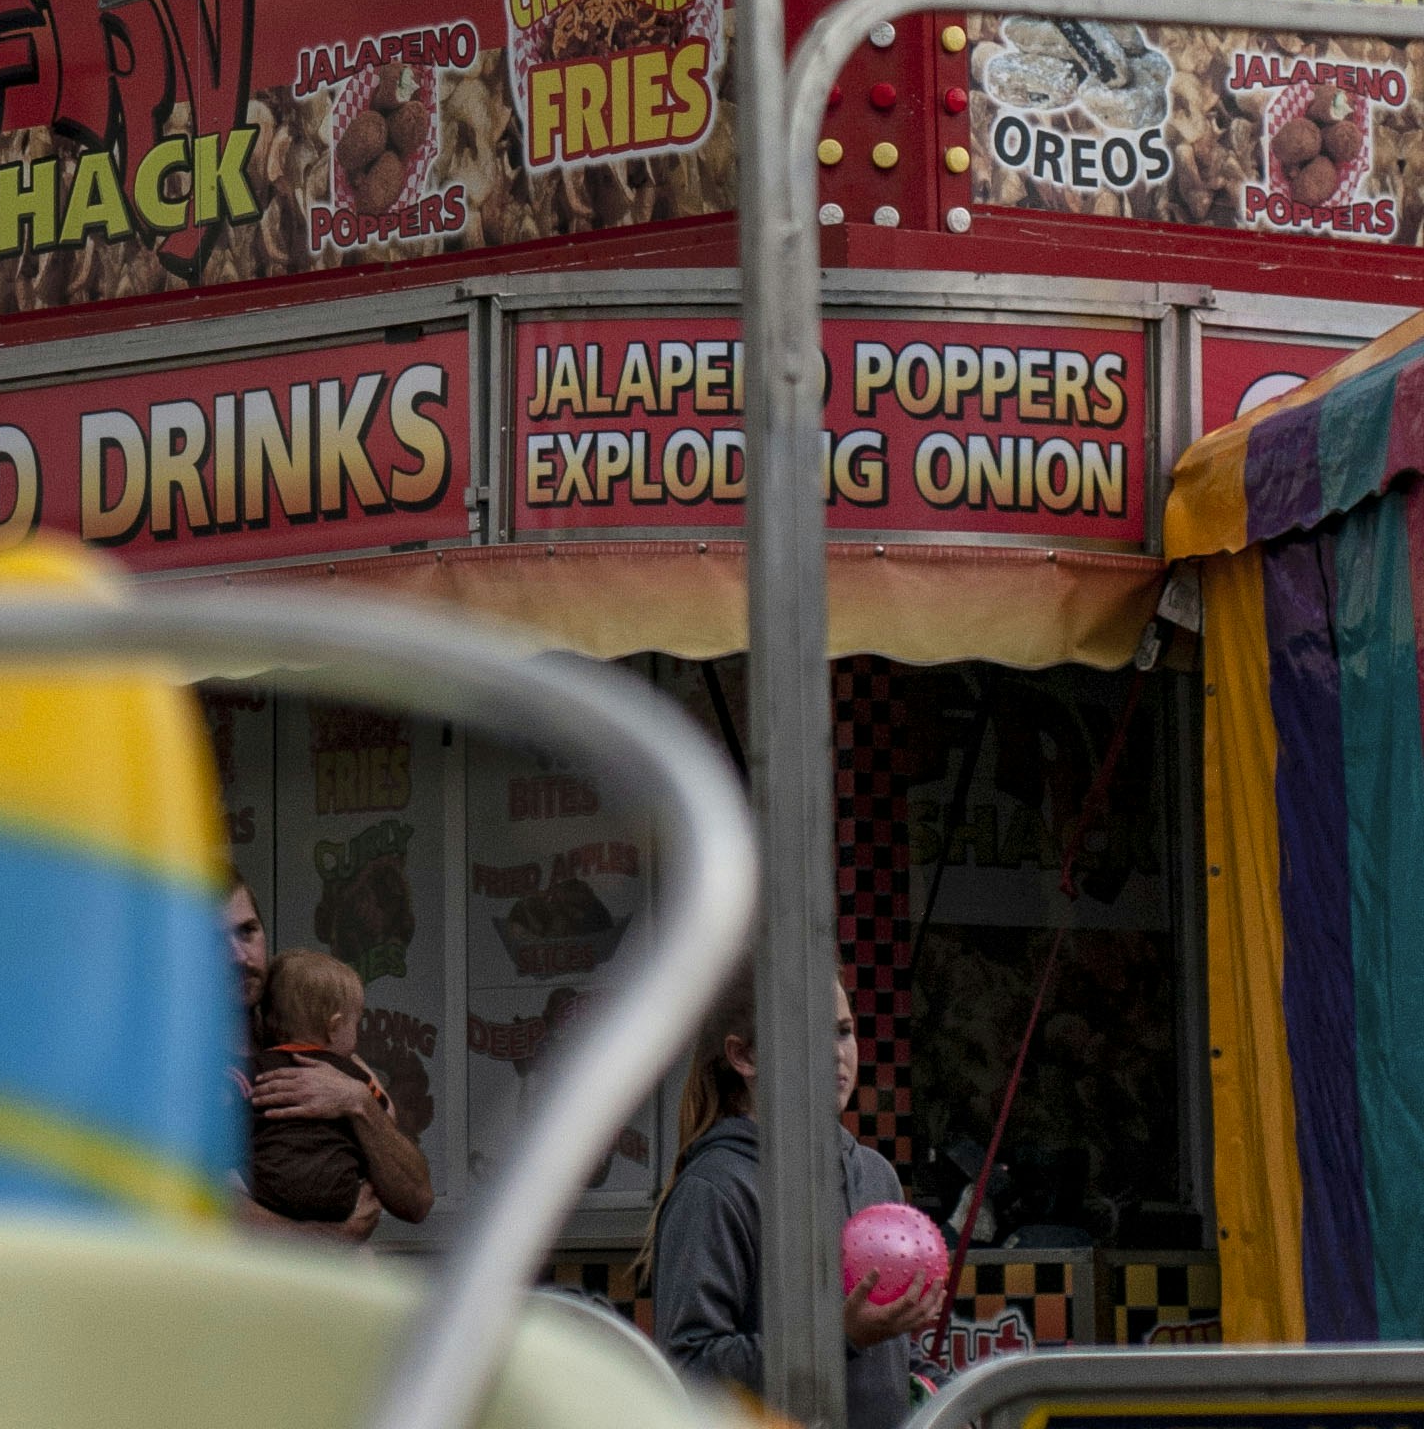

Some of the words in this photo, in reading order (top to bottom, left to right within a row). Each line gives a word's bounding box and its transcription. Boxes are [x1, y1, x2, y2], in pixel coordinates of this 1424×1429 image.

[294, 22, 478, 99] JALAPENO
[1229, 53, 1407, 109] JALAPENO
[528, 34, 714, 166] FRIES
[993, 114, 1171, 190] OREOS
[310, 184, 467, 251] POPPERS
[1244, 185, 1396, 237] POPPERS
[526, 341, 832, 421] JALAPE
[853, 341, 1129, 428] POPPERS
[79, 362, 451, 549] DRINKS
[525, 428, 888, 508] EXPLODG
[912, 431, 1128, 519] ONION
